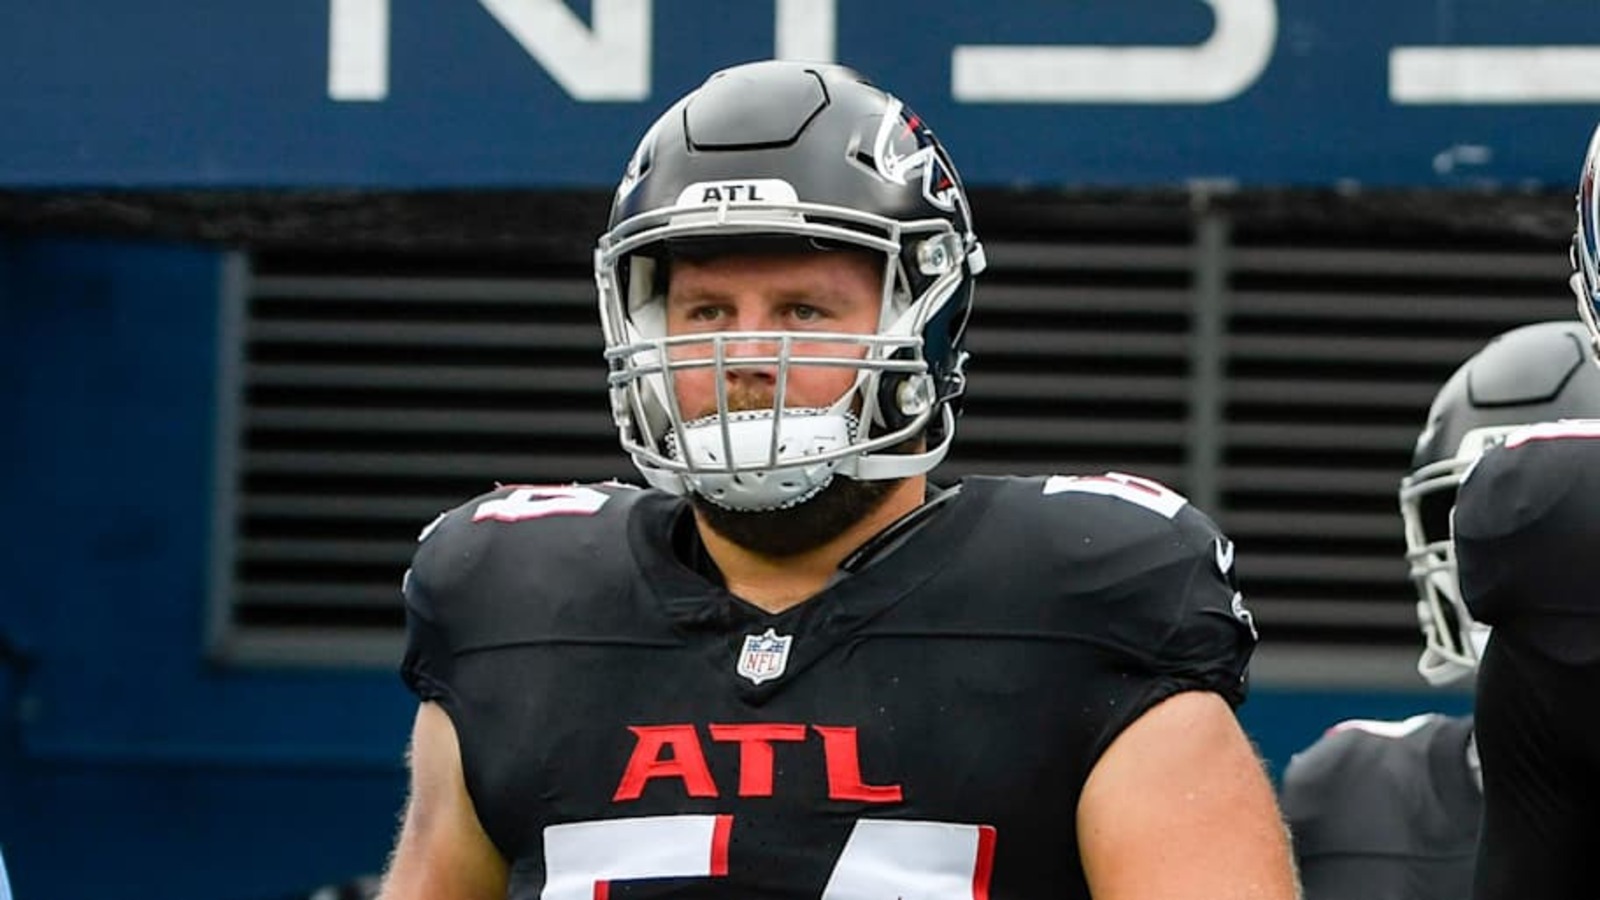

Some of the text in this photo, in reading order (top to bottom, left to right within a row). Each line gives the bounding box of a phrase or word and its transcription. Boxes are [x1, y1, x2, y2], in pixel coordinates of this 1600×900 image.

[702, 185, 763, 202] ATL
[746, 653, 775, 673] NFL
[612, 724, 903, 802] ATL
